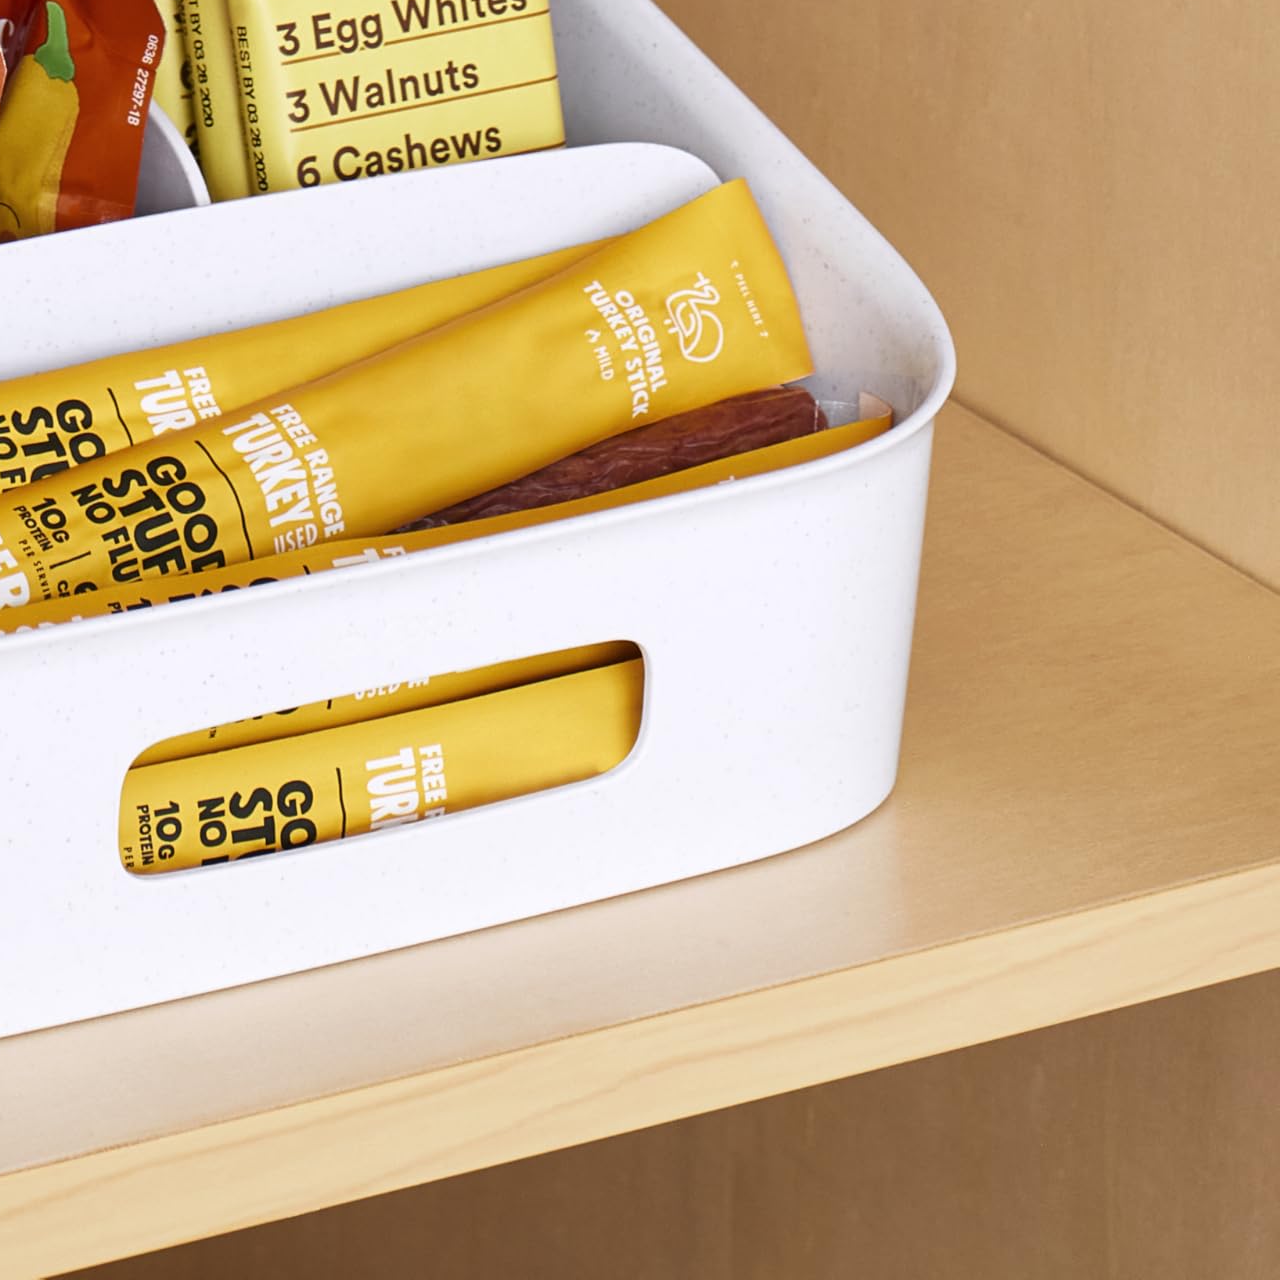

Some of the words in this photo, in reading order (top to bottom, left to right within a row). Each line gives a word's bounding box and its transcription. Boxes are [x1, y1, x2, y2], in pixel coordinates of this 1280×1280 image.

[142, 34, 159, 65] 0636
[190, 13, 202, 37] BY
[192, 40, 204, 60] 03
[237, 26, 252, 72] BEST
[276, 22, 300, 56] 3
[312, 12, 384, 54] Egg
[199, 88, 214, 128] 2020
[243, 76, 256, 100] BY
[286, 89, 310, 123] 3
[318, 61, 480, 117] Walnuts
[253, 152, 267, 192] 2020
[296, 155, 321, 188] 6
[333, 126, 502, 182] Cashews
[584, 280, 639, 351] TURKEY
[626, 357, 649, 418] STICK
[594, 345, 614, 380] MILD
[615, 290, 667, 393] ORIGINAL
[183, 367, 222, 419] FREE
[222, 411, 314, 528] TURKEY
[270, 404, 318, 448] FREE
[304, 448, 345, 538] RANGE
[13, 505, 54, 552] PROTEIN
[71, 483, 116, 524] NO
[102, 526, 144, 584] FLU
[102, 469, 189, 576] STUF
[19, 539, 35, 559] PER
[365, 745, 420, 829] TUR
[419, 744, 447, 804] FREE
[136, 804, 154, 867] PROTEIN
[197, 796, 227, 847] NO
[228, 787, 277, 861] ST
[123, 846, 134, 868] PER
